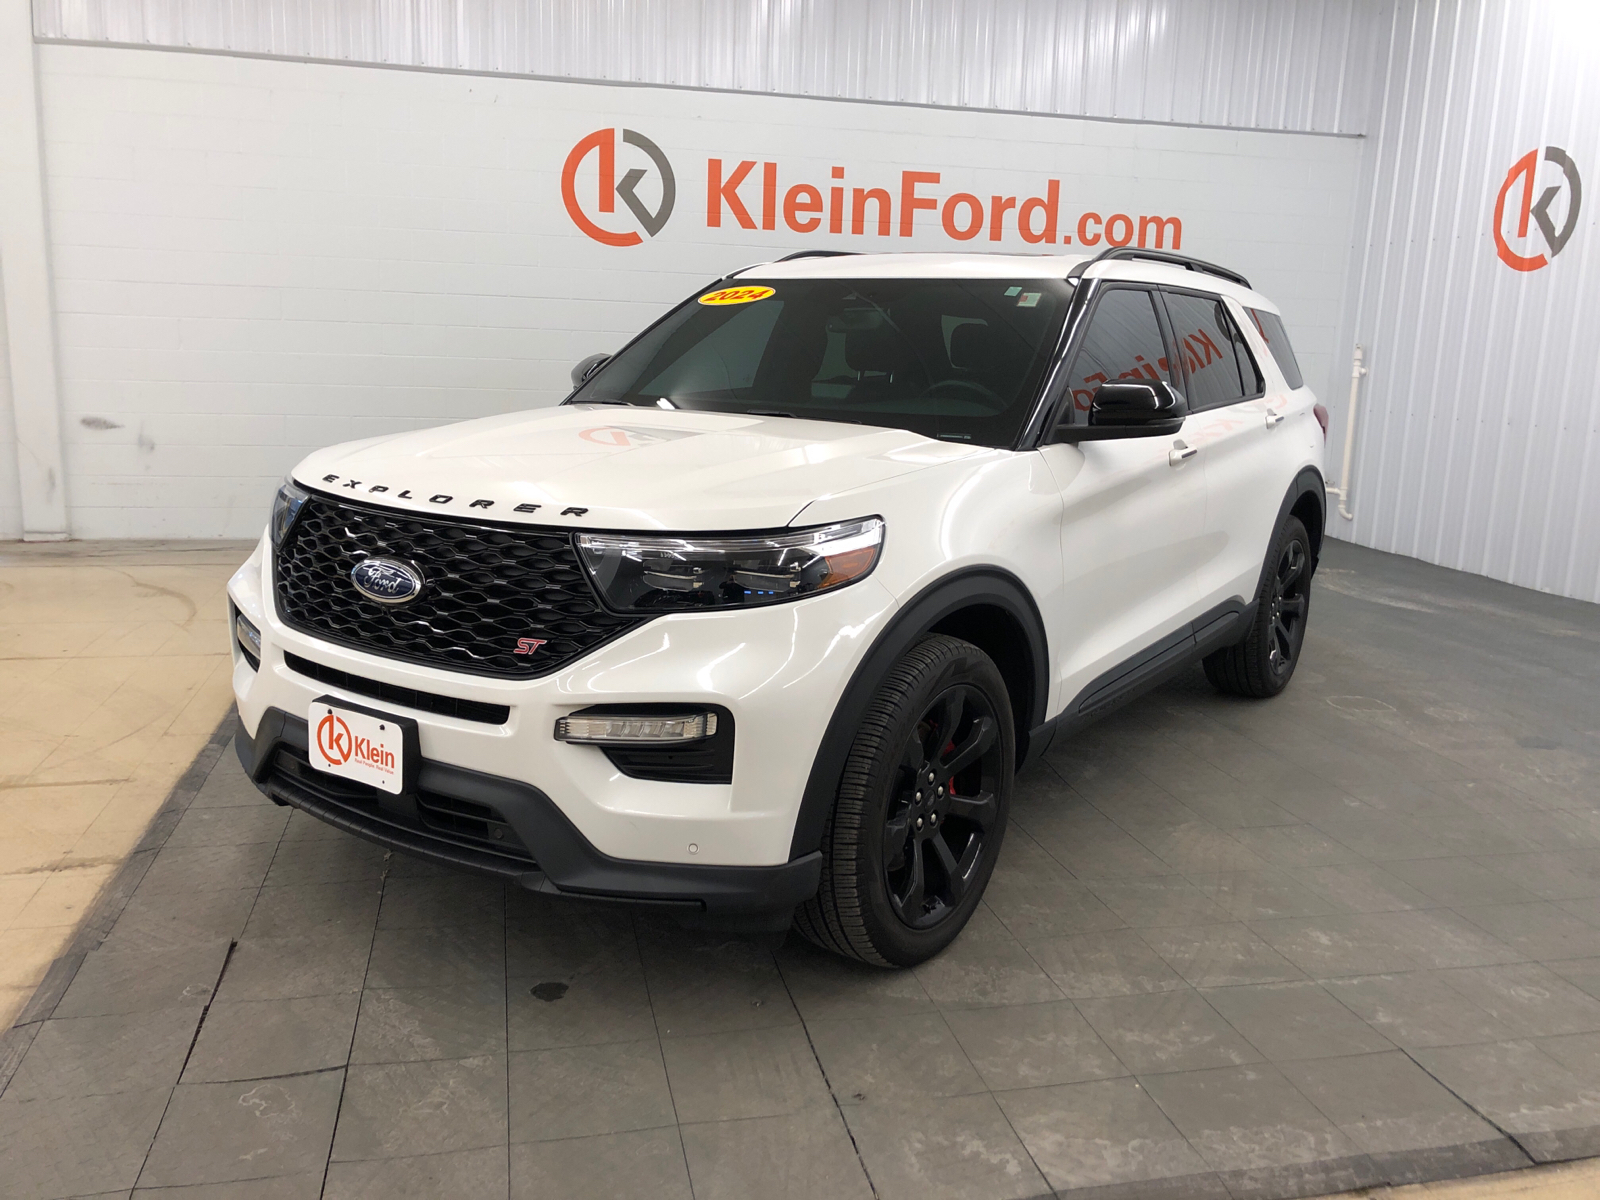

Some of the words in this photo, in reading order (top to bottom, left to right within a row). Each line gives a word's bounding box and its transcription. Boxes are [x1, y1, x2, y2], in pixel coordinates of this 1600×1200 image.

[706, 158, 1183, 250] KleinFord.com
[703, 289, 770, 300] 2024
[322, 473, 589, 517] EXPLORER
[363, 566, 400, 594] Ford
[513, 637, 547, 655] ST
[354, 735, 395, 769] Klein
